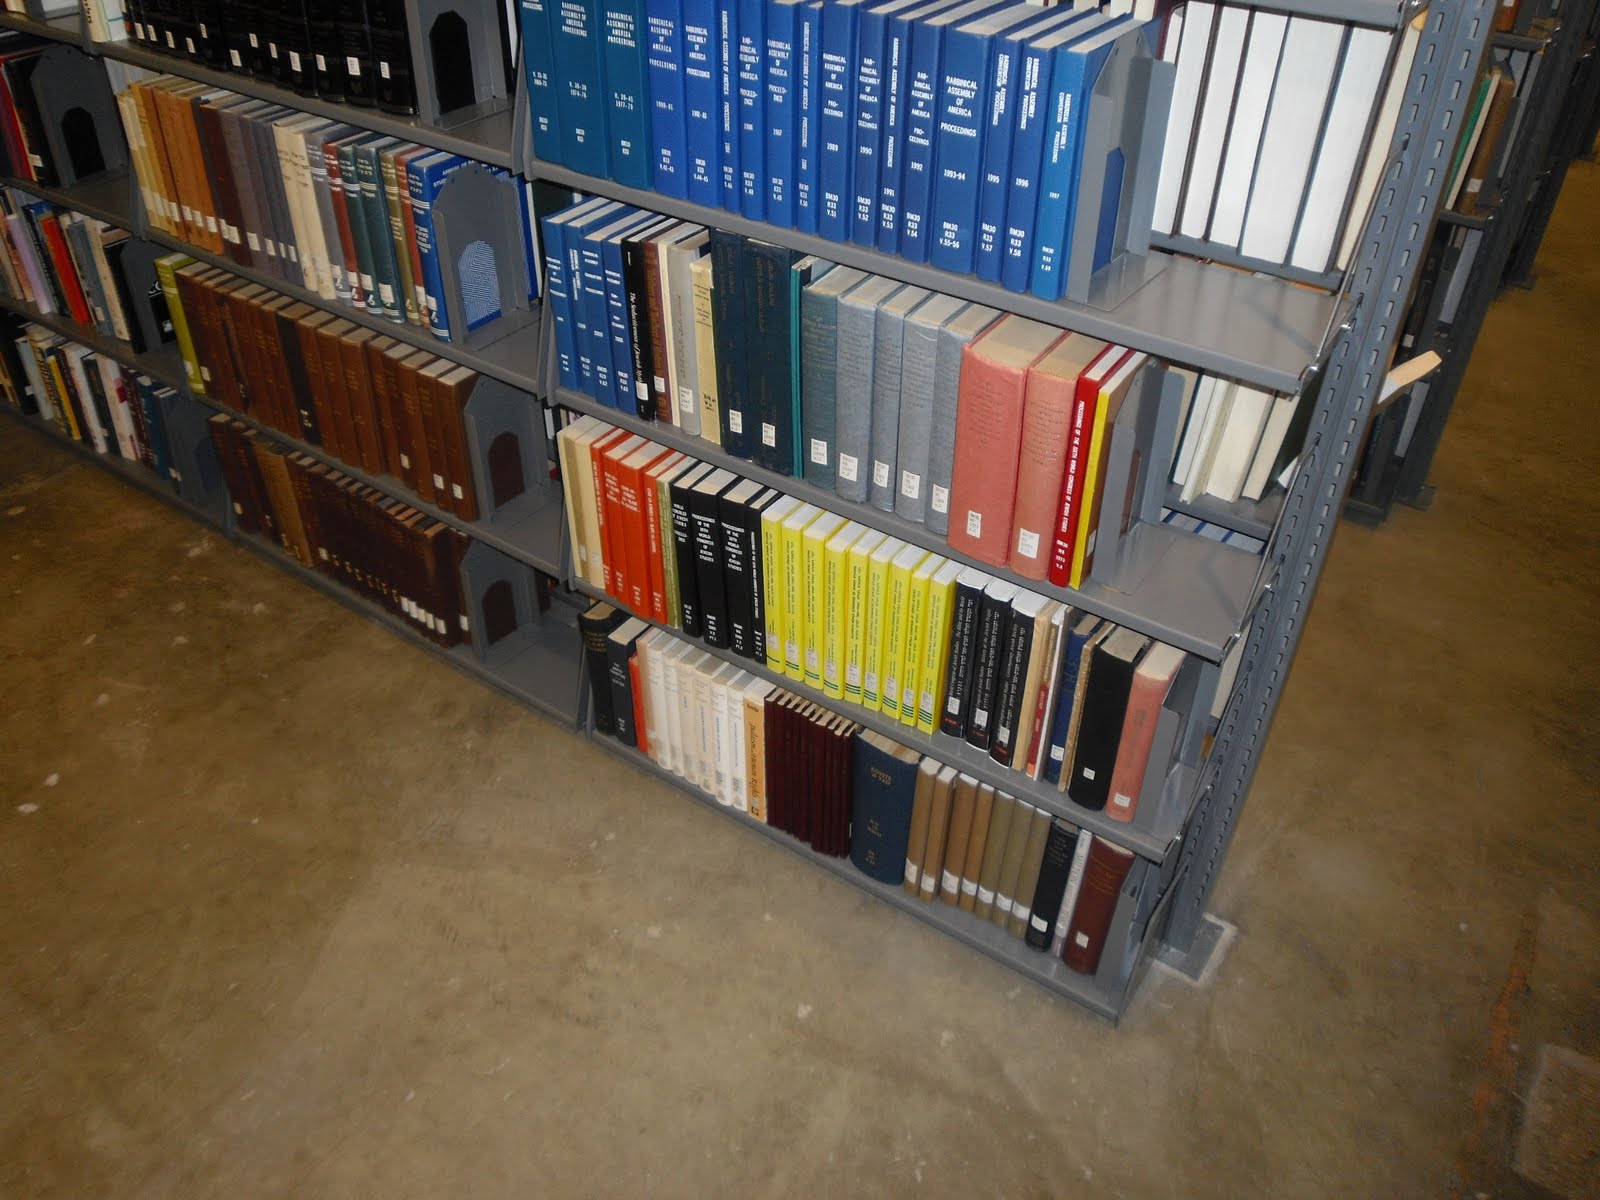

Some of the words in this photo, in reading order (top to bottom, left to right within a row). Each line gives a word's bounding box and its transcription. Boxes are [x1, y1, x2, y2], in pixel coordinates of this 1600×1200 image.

[825, 63, 845, 72] ASSEMBLY
[860, 75, 880, 85] ASSEMBLY
[946, 76, 978, 90] RABBINICAL
[826, 81, 843, 91] AMERICA
[912, 90, 934, 100] ASSEMBLY
[948, 86, 976, 99] ASSEMBLY
[860, 94, 878, 103] AMERICA
[956, 98, 964, 106] OF
[993, 91, 1001, 126] PROCEEDINGS
[1028, 91, 1036, 118] ASSEMBLY
[912, 108, 930, 118] AMERICA
[948, 106, 972, 117] AMERICA
[1021, 94, 1029, 130] PROCEEDINGS
[941, 122, 977, 137] PROCEEDINGS
[827, 143, 838, 152] 1989
[860, 146, 872, 155] 1990
[1052, 131, 1060, 163] PROCEEDINGS
[911, 162, 923, 170] 1992
[944, 169, 966, 180] 1993-94
[988, 174, 1000, 184] 1995
[1016, 178, 1029, 188] 1996
[884, 187, 895, 196] 1991
[1050, 192, 1060, 200] 1997
[859, 205, 869, 213] R33
[882, 204, 896, 213] BM30
[858, 213, 869, 221] V.52
[883, 213, 893, 221] R33
[907, 212, 921, 222] BM30
[882, 220, 893, 229] V.53
[908, 221, 918, 230] R33
[943, 222, 958, 231] BM30
[982, 223, 997, 233] BM30
[907, 229, 918, 238] V.54
[945, 231, 955, 239] R33
[983, 233, 993, 242] R33
[1010, 227, 1025, 238] BM30
[940, 238, 960, 248] V.55-56
[982, 243, 993, 252] V.57
[1011, 238, 1022, 247] R33
[1010, 247, 1021, 257] V.58
[1076, 400, 1085, 429] PROCEEDINGS
[1067, 474, 1075, 495] CONGRESS
